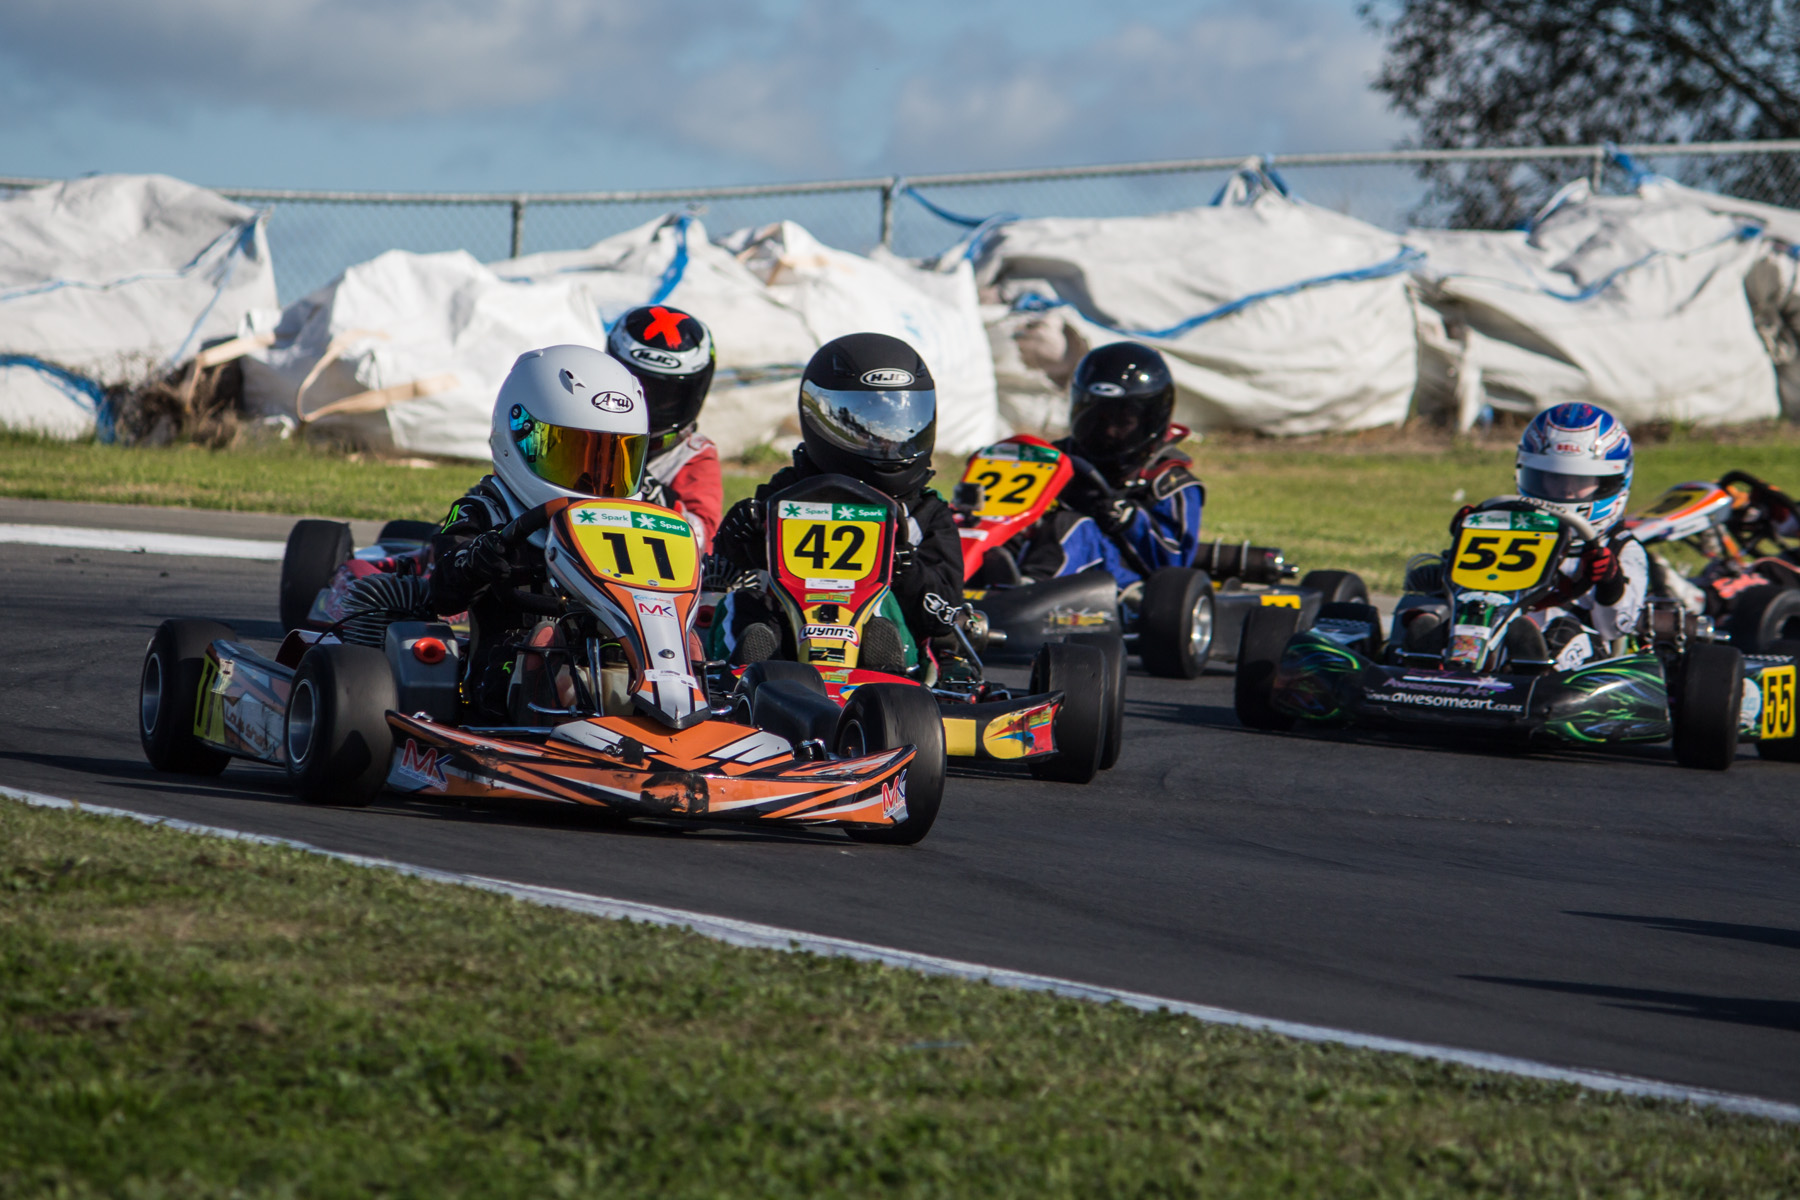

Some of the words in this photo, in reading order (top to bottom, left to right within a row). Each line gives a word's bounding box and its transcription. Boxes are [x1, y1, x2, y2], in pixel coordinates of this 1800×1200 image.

[637, 350, 673, 366] HJC
[871, 373, 907, 382] HJC
[595, 393, 630, 408] Arai
[1556, 443, 1581, 453] BELL
[976, 471, 1037, 505] 22
[601, 513, 629, 522] Spark
[804, 507, 829, 515] Spark
[858, 509, 883, 517] Spark
[659, 520, 687, 533] Spark
[602, 531, 676, 581] 11
[793, 524, 865, 572] 42
[1457, 536, 1541, 572] 55
[638, 602, 675, 618] MK
[1383, 677, 1460, 694] Awesome
[1767, 674, 1791, 735] 55
[402, 738, 454, 783] MK
[882, 769, 907, 812] MK
